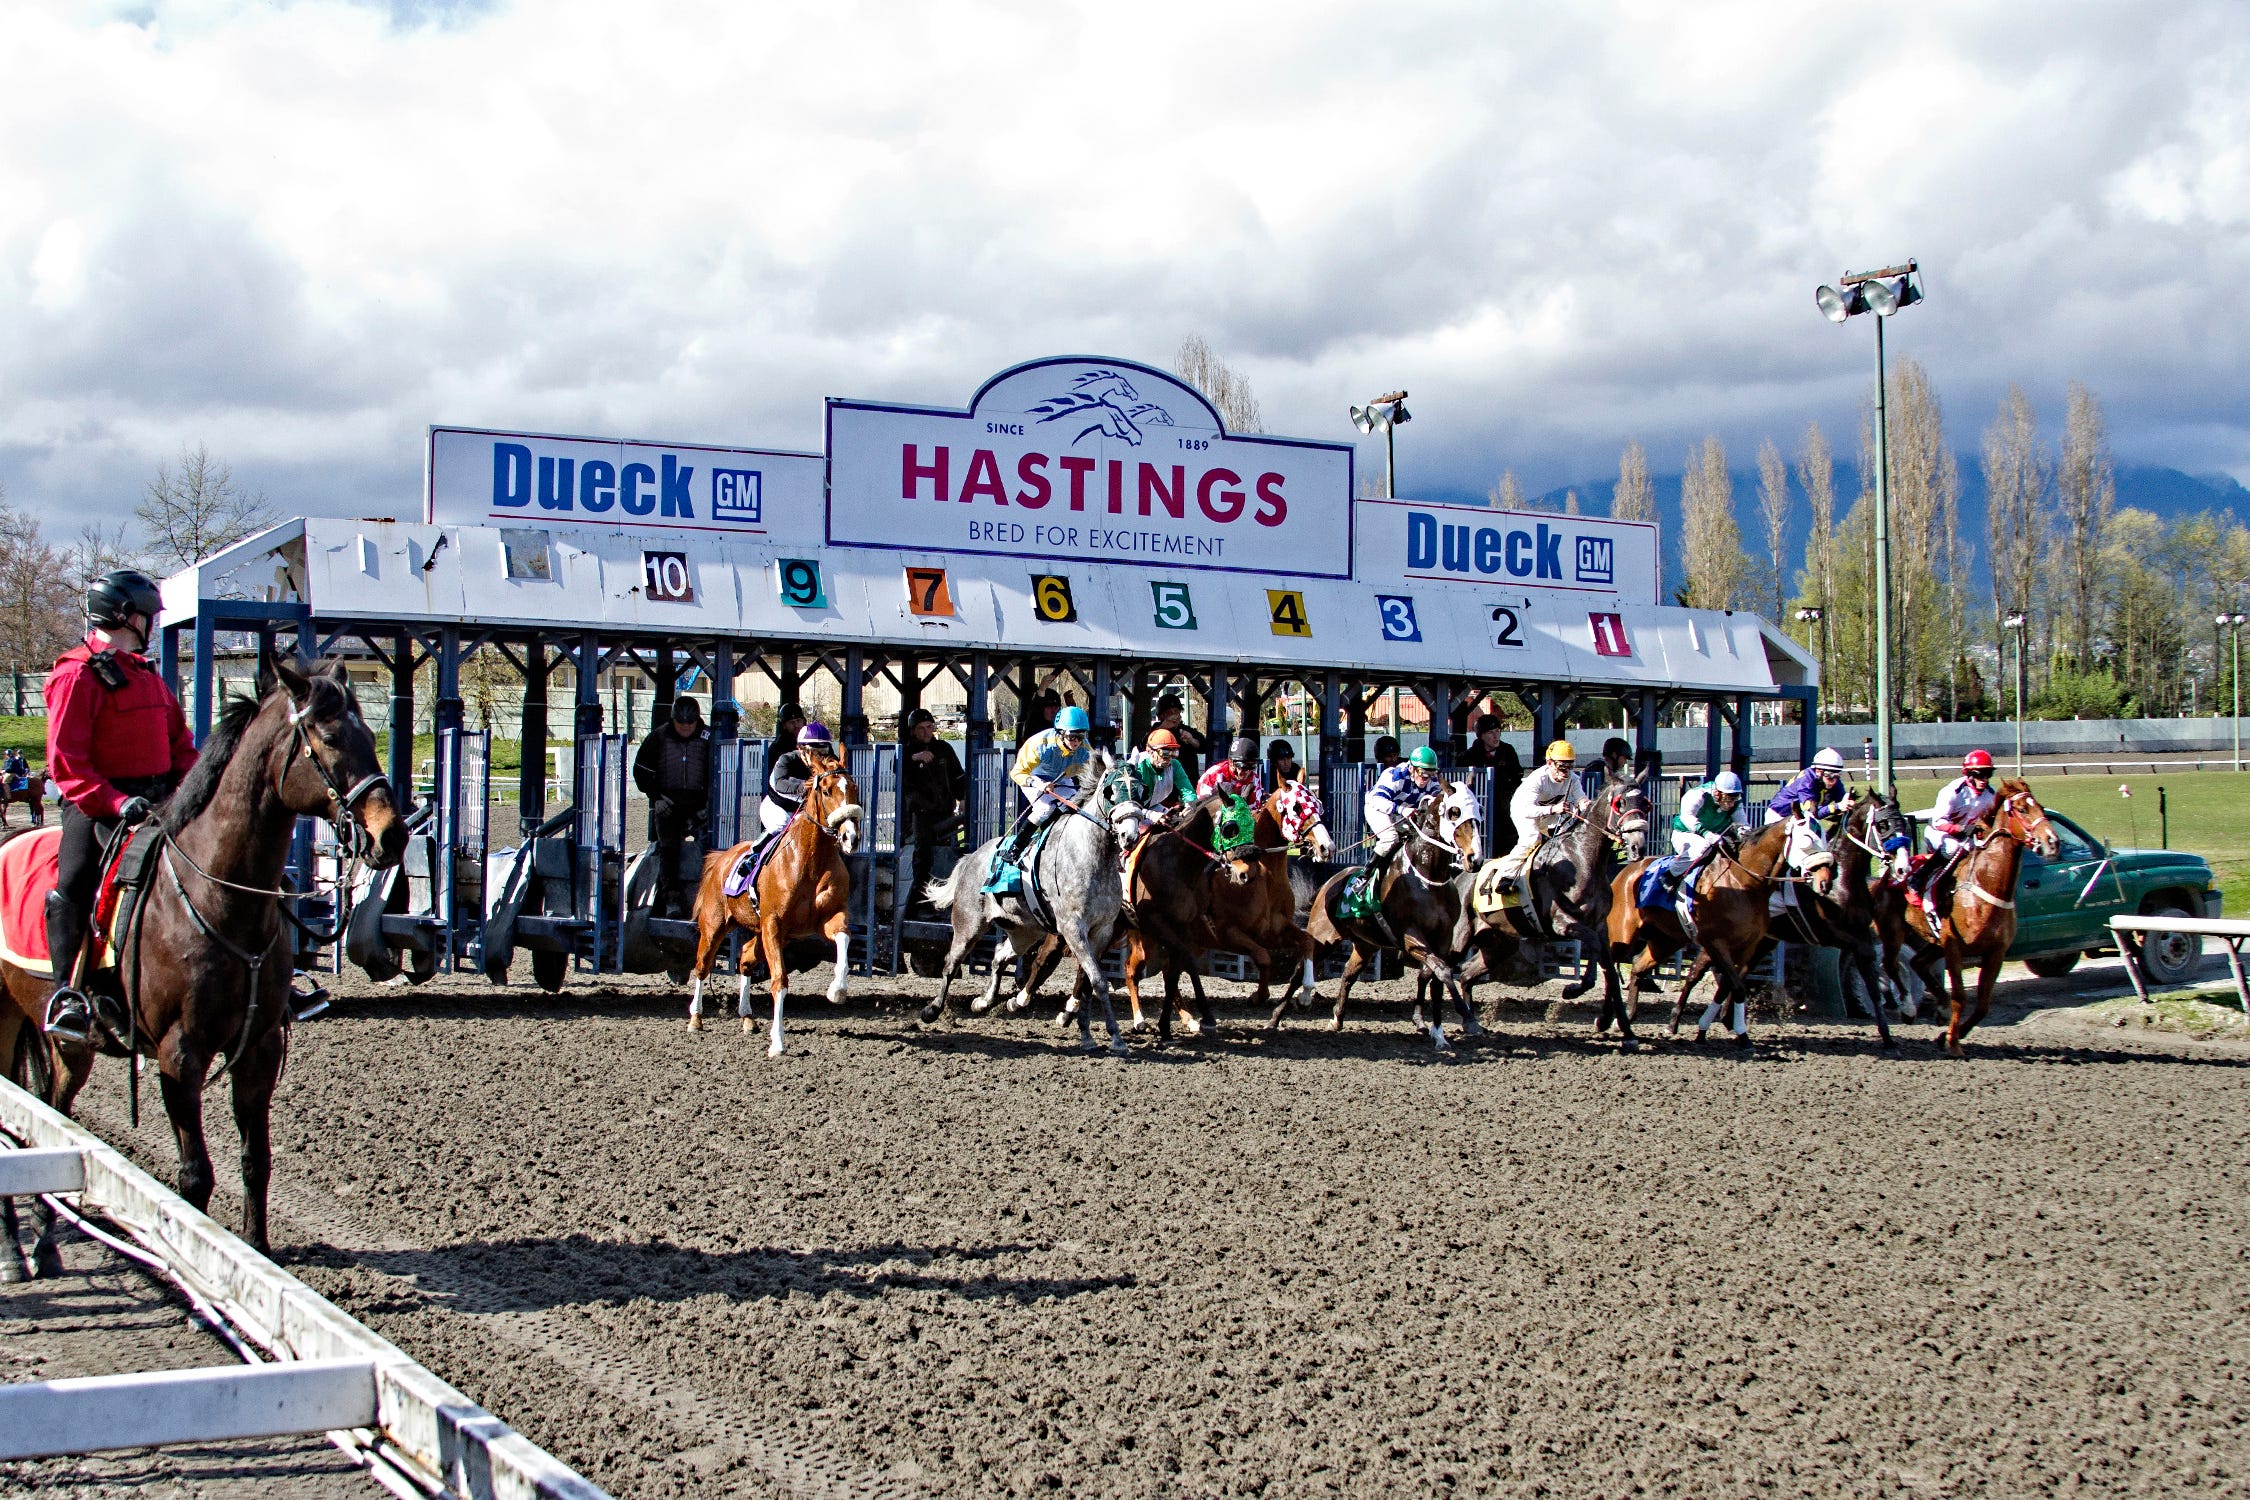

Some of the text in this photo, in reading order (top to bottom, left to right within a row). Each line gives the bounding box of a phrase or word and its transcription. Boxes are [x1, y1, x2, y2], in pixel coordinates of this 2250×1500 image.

[987, 422, 1025, 436] SINCE
[1178, 438, 1209, 451] 1889
[492, 442, 760, 519] Dueck GM
[902, 443, 1288, 528] HASTINGS
[969, 520, 1225, 557] BRED FOR EXCITEMENT
[1408, 511, 1611, 580] Dueck GM
[646, 556, 687, 598] 10
[785, 561, 818, 604] 9
[909, 573, 942, 612] 7
[1038, 577, 1069, 620] 6
[1158, 587, 1191, 627] 5
[1273, 594, 1306, 634] 4
[1383, 598, 1415, 638] 3
[1492, 607, 1524, 647] 2
[1598, 615, 1619, 653] 1
[1479, 868, 1499, 906] 4
